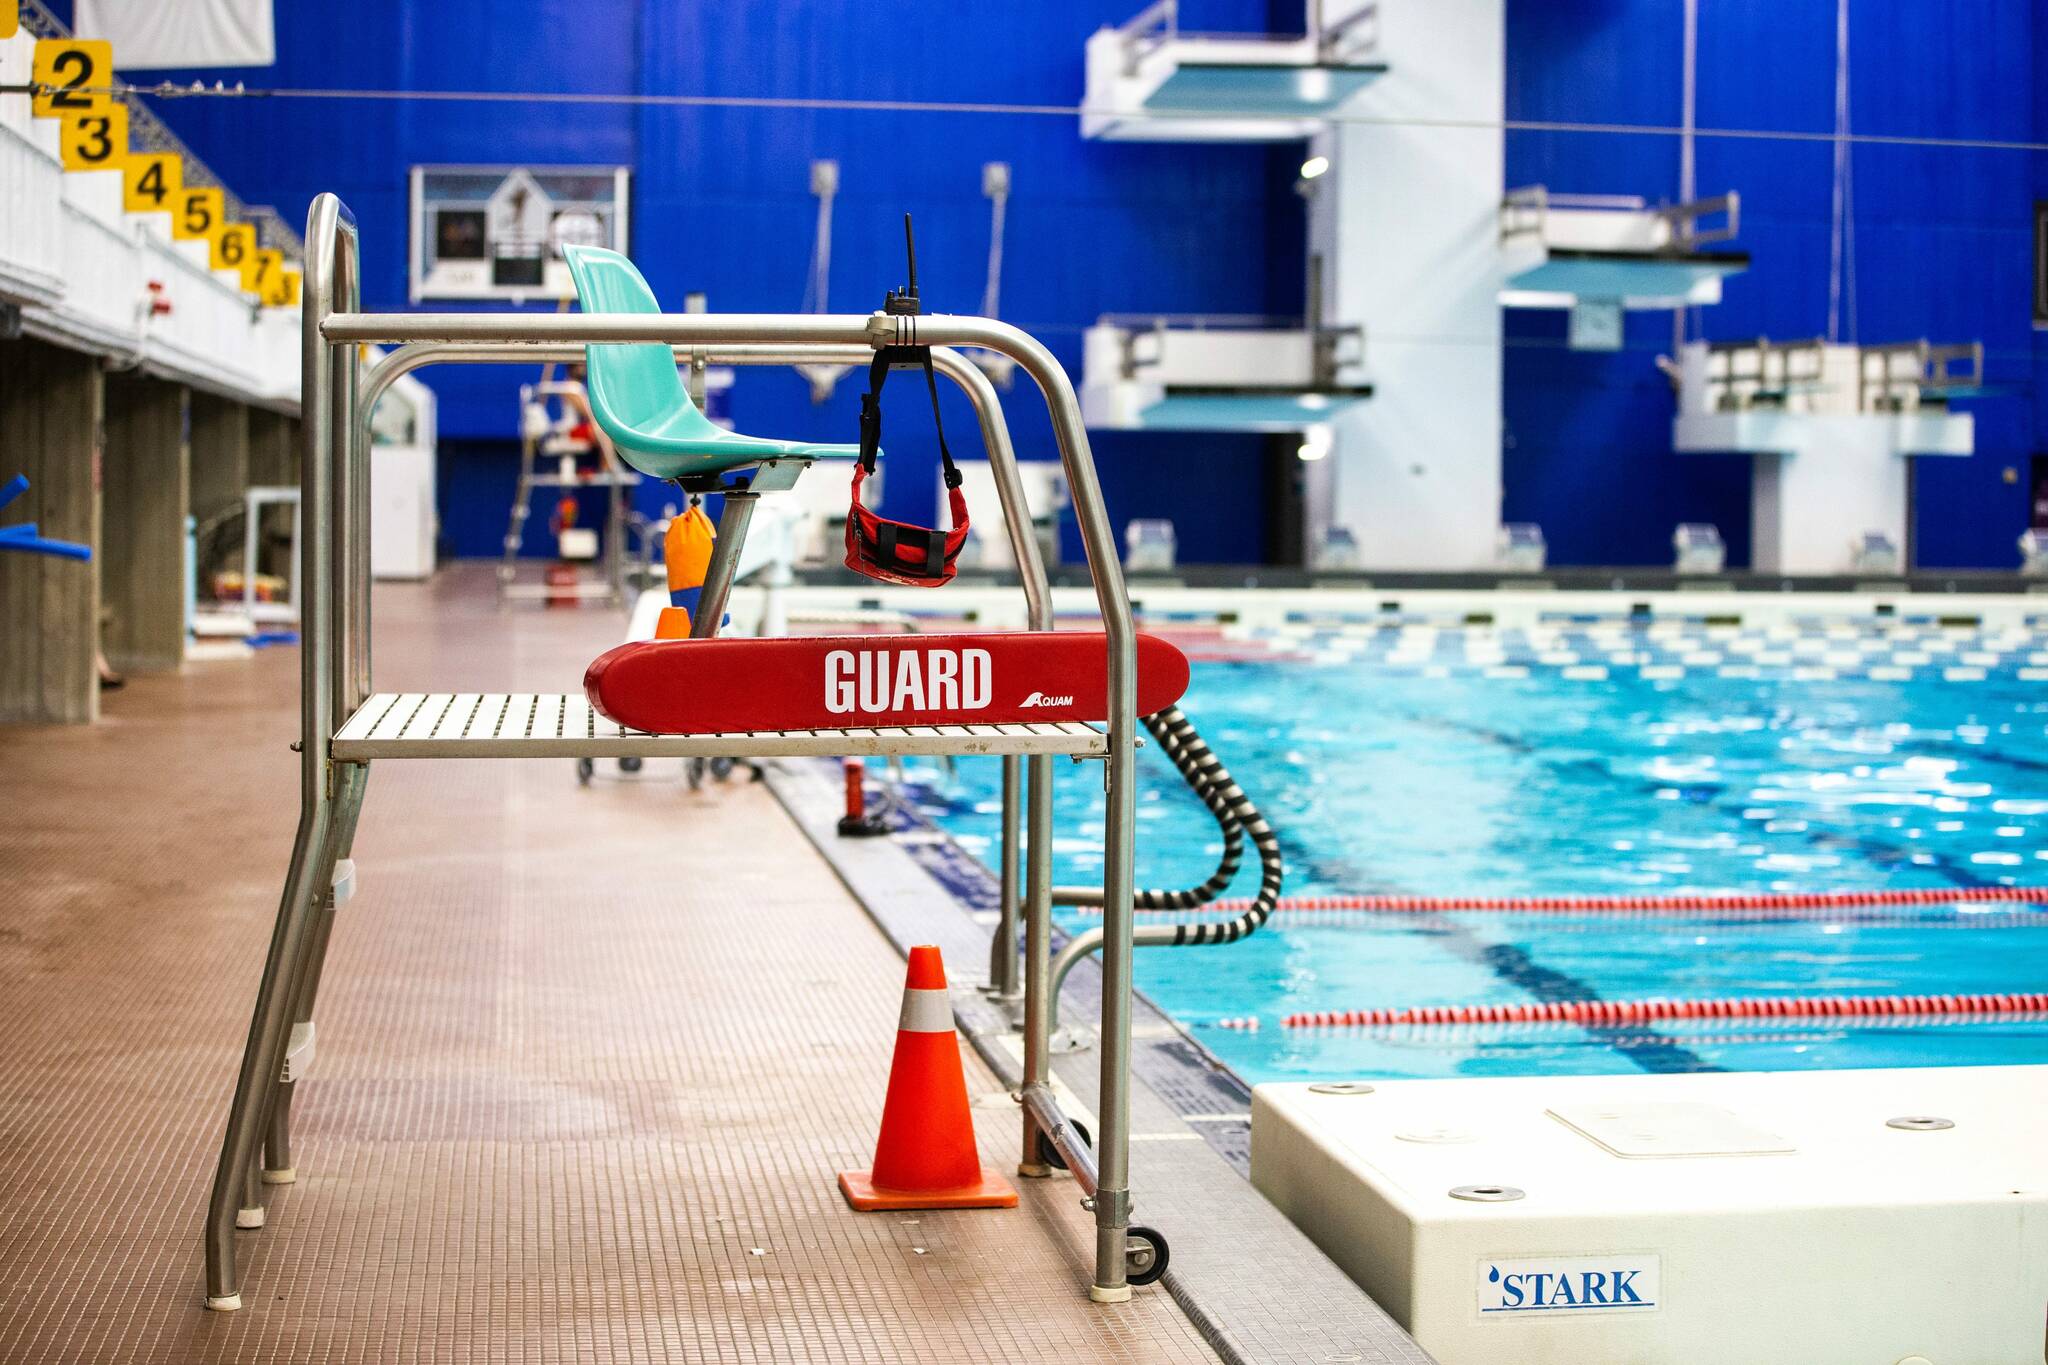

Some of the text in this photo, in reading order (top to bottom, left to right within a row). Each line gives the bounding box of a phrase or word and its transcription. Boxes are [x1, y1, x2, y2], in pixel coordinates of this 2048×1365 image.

[50, 49, 94, 109] 2
[77, 117, 113, 162] 3
[136, 161, 169, 206] 4
[184, 195, 211, 234] 5
[220, 230, 244, 266] 6
[824, 648, 992, 714] GUARD
[1018, 692, 1074, 708] AQUAM
[1502, 1270, 1642, 1308] STARK
